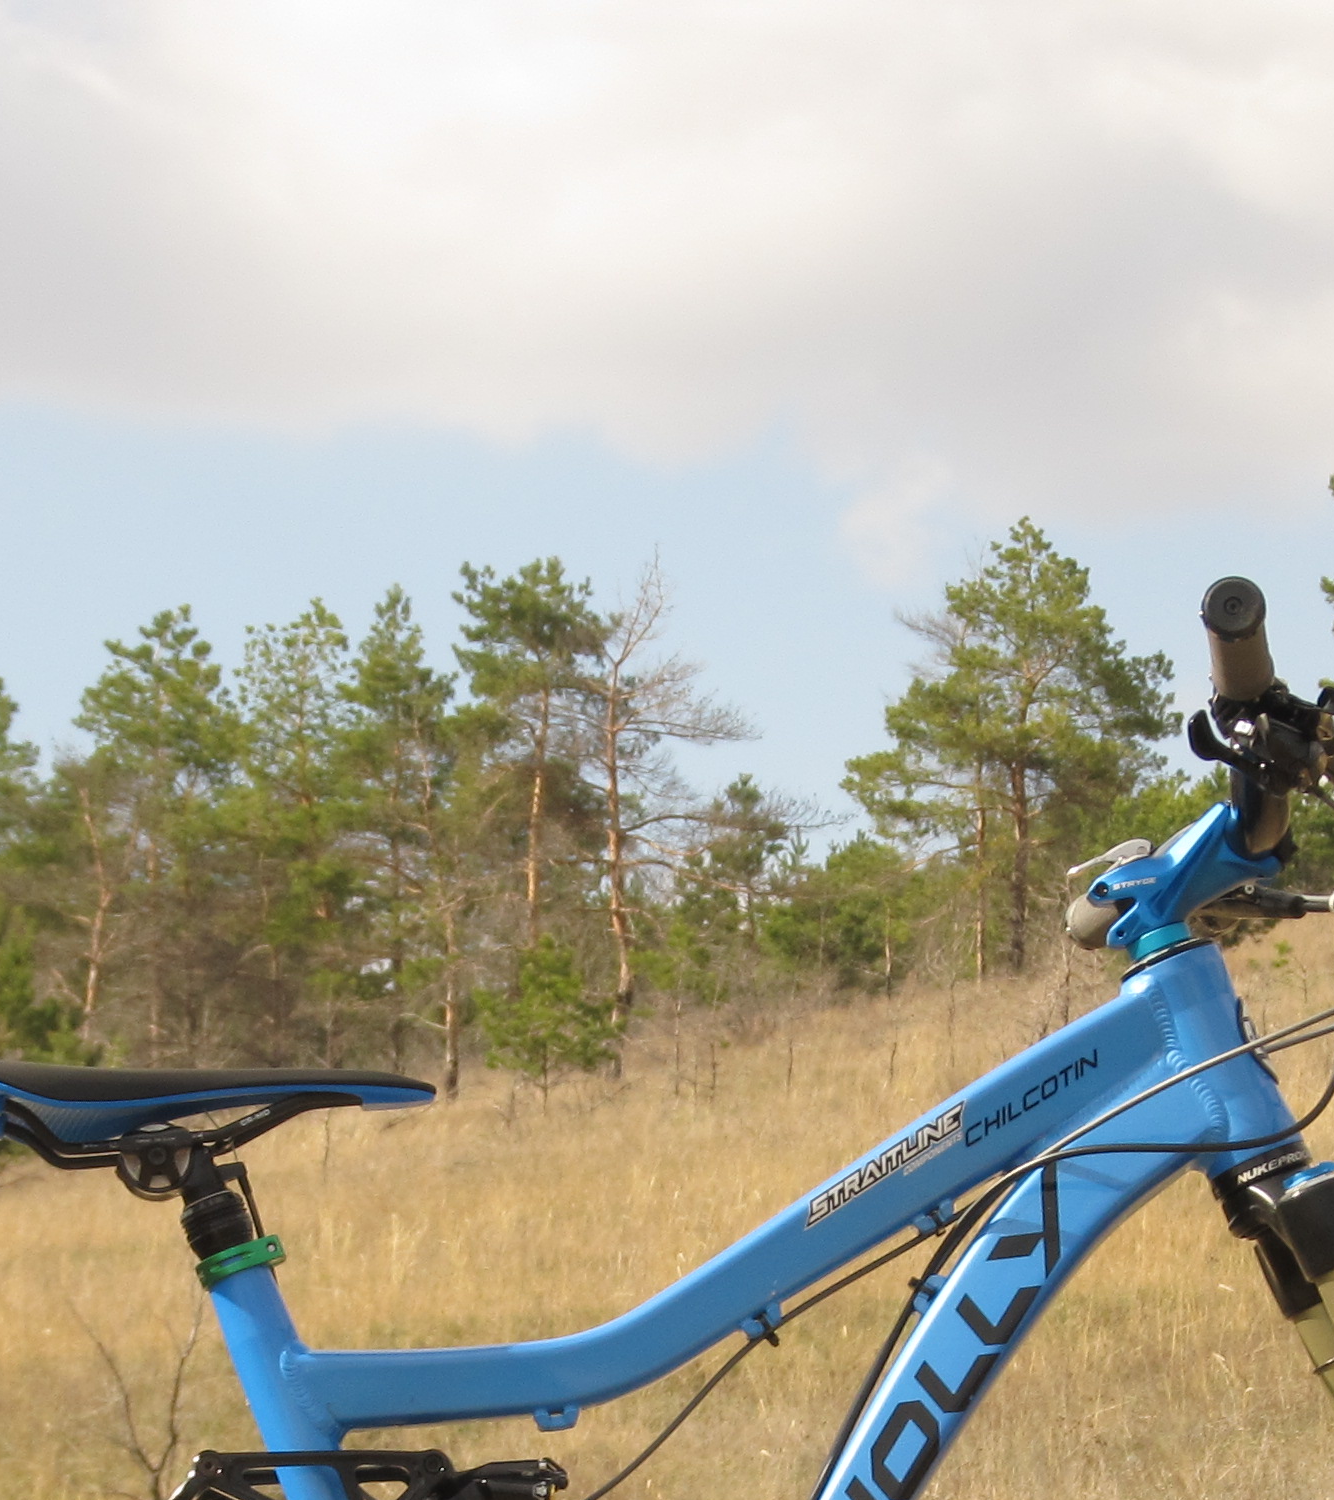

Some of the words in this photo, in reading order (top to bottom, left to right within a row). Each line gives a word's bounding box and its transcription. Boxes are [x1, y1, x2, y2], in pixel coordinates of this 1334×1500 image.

[966, 1048, 1098, 1147] CHILCOTIN
[807, 1101, 964, 1223] STRAITLINE
[903, 1132, 963, 1176] COMPONENTS
